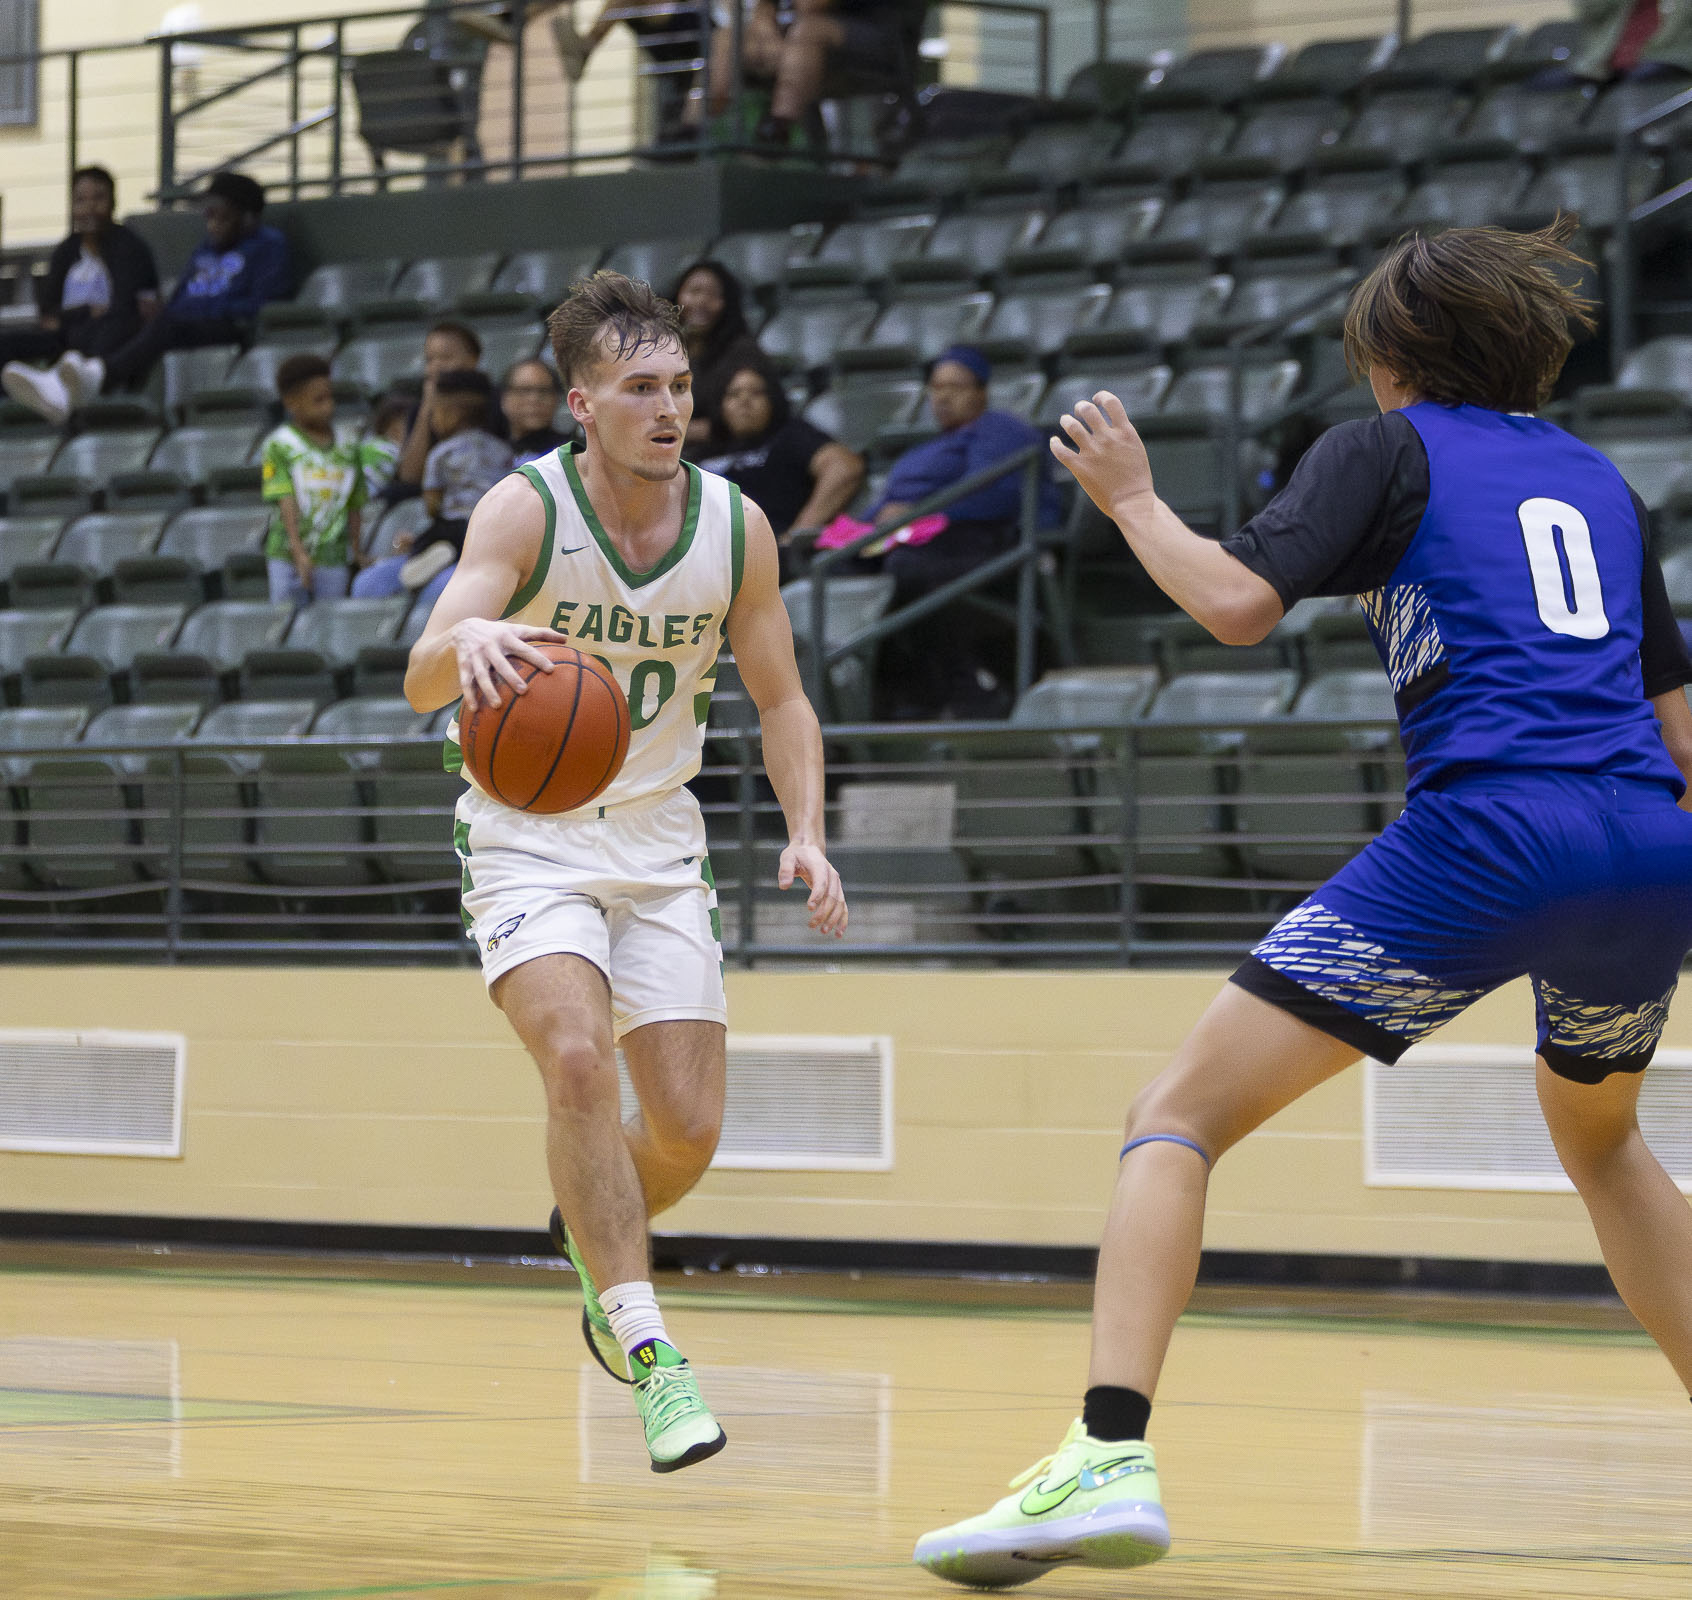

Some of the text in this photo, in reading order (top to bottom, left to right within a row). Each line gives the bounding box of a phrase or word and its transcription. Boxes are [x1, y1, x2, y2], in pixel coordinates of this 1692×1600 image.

[1517, 497, 1610, 640] 0
[550, 600, 714, 649] EAGLES
[590, 654, 677, 732] 0
